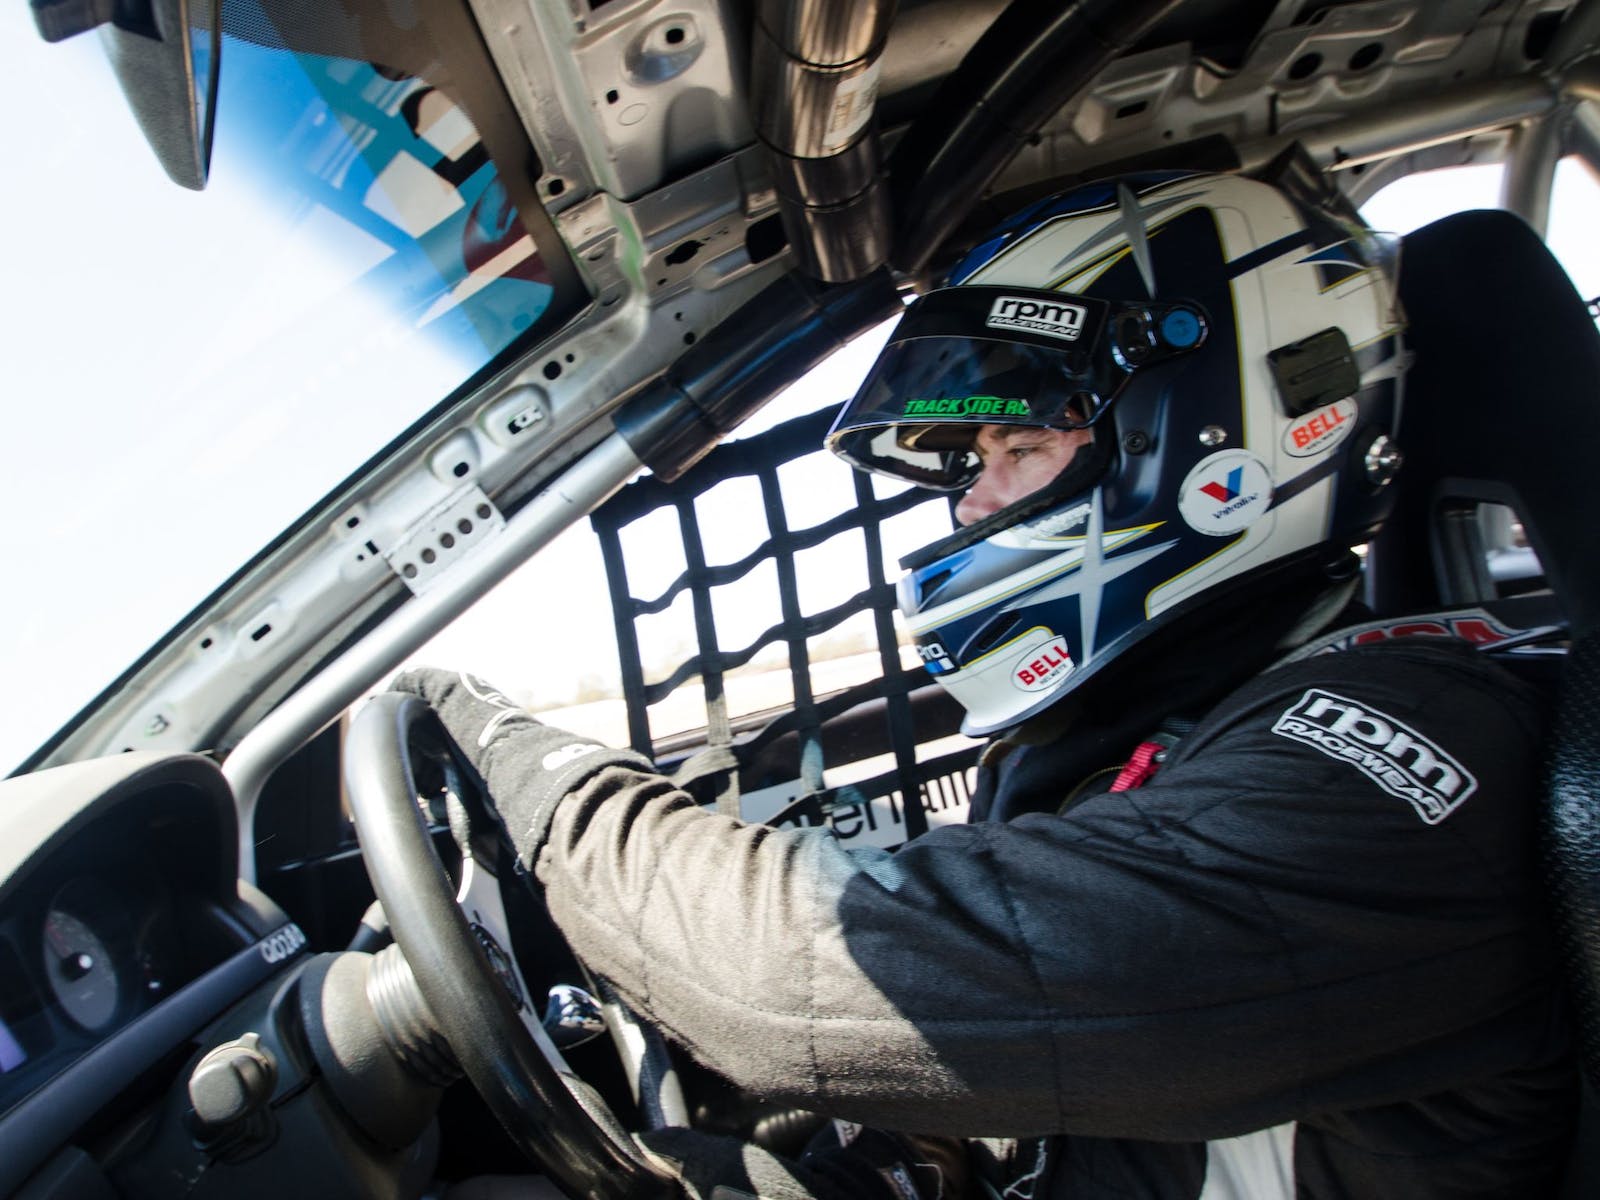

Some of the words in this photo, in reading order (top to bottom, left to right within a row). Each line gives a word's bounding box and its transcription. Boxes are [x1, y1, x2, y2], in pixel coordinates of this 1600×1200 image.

[999, 300, 1079, 326] rpm
[1291, 405, 1346, 448] BELL
[1017, 645, 1070, 686] BELL
[1278, 719, 1445, 817] RACEWEAR
[1302, 697, 1462, 798] rpm
